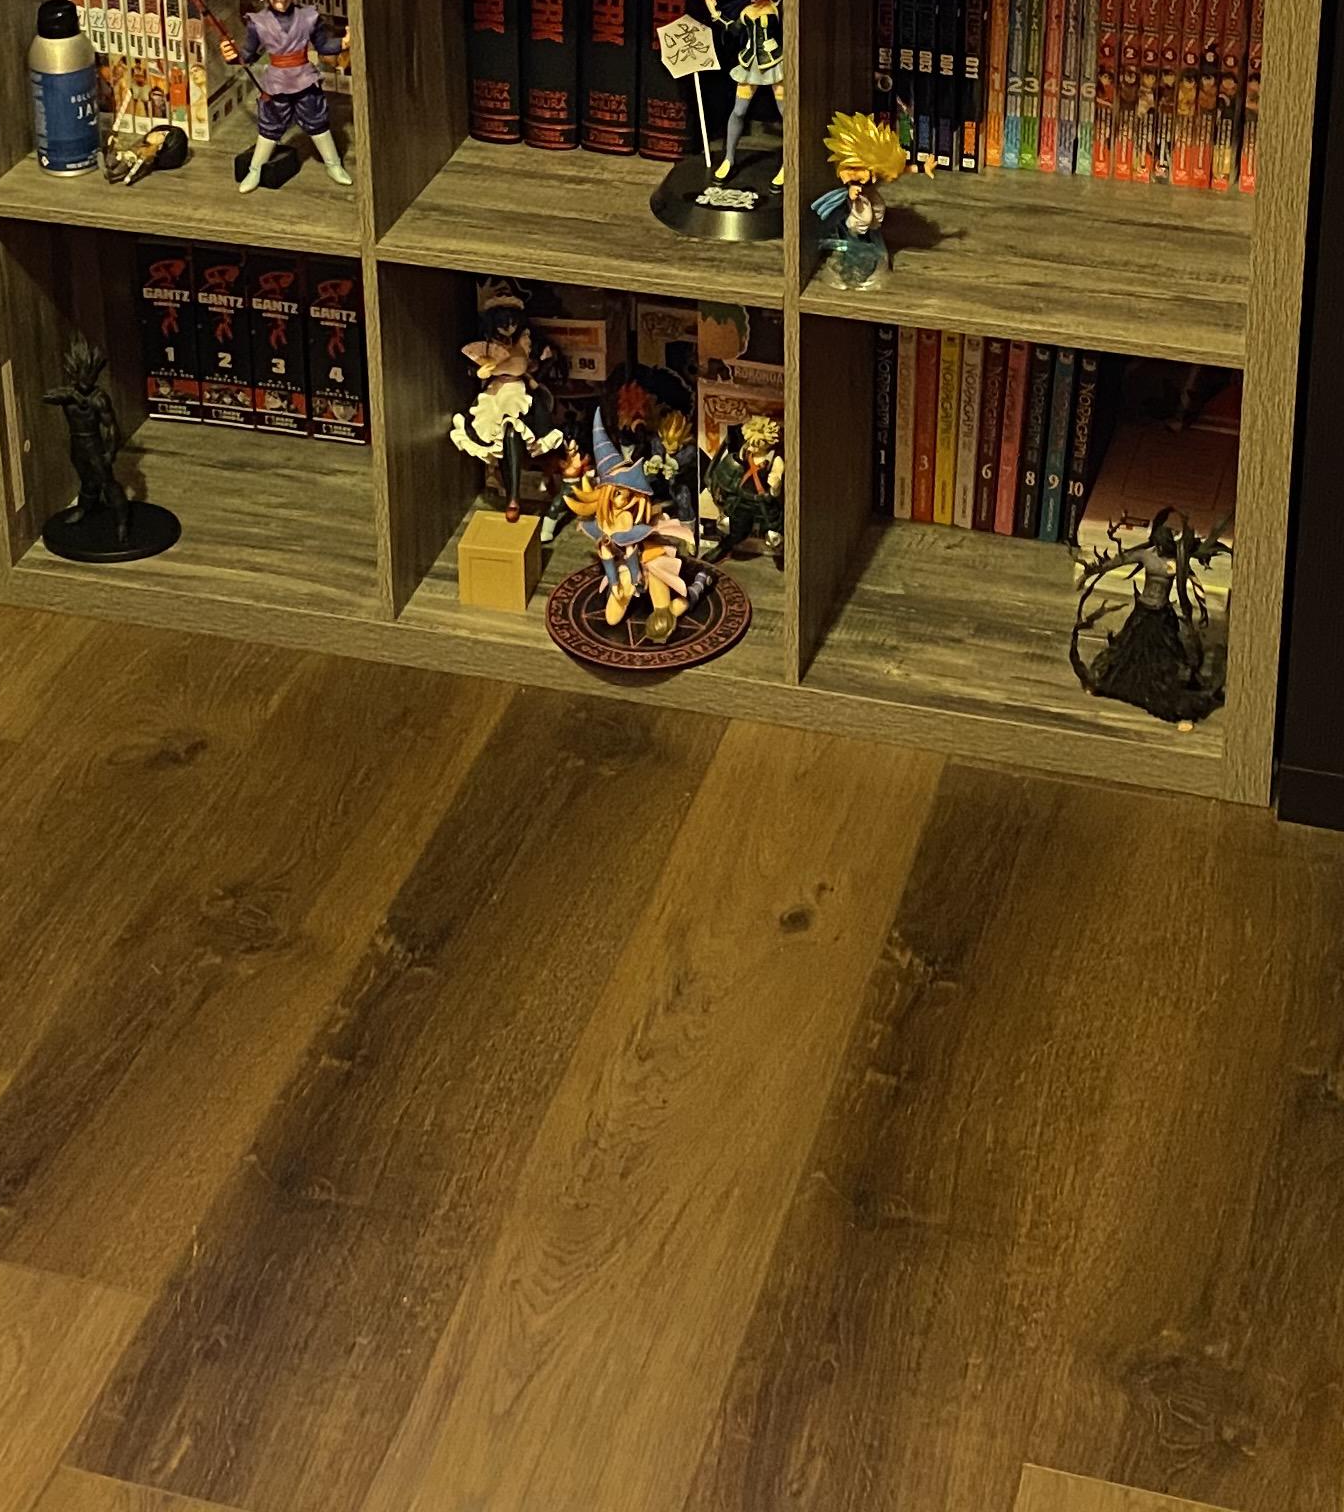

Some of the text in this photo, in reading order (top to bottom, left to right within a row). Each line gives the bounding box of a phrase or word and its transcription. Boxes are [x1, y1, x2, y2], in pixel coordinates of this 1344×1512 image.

[993, 73, 1001, 89] 1
[1008, 77, 1023, 93] 2
[1024, 77, 1039, 93] 3
[1043, 79, 1056, 94] 4
[1061, 80, 1077, 96] 5
[474, 89, 510, 101] MIURA
[1081, 82, 1096, 98] 6
[530, 97, 567, 111] MIURA
[590, 99, 628, 112] MIURA
[648, 106, 686, 120] MIURA
[143, 287, 190, 302] GANTZ
[197, 292, 244, 308] GANTZ
[252, 298, 299, 314] GANTZ
[310, 306, 357, 323] GANTZ
[165, 347, 175, 362] 1
[217, 352, 233, 368] 2
[271, 358, 286, 374] 3
[578, 358, 595, 370] 98
[329, 367, 344, 383] 4
[879, 450, 886, 465] 1
[919, 455, 929, 471] 3
[981, 463, 992, 480] 6
[1025, 471, 1036, 486] 8
[1048, 474, 1060, 490] 9
[1067, 480, 1084, 498] 10
